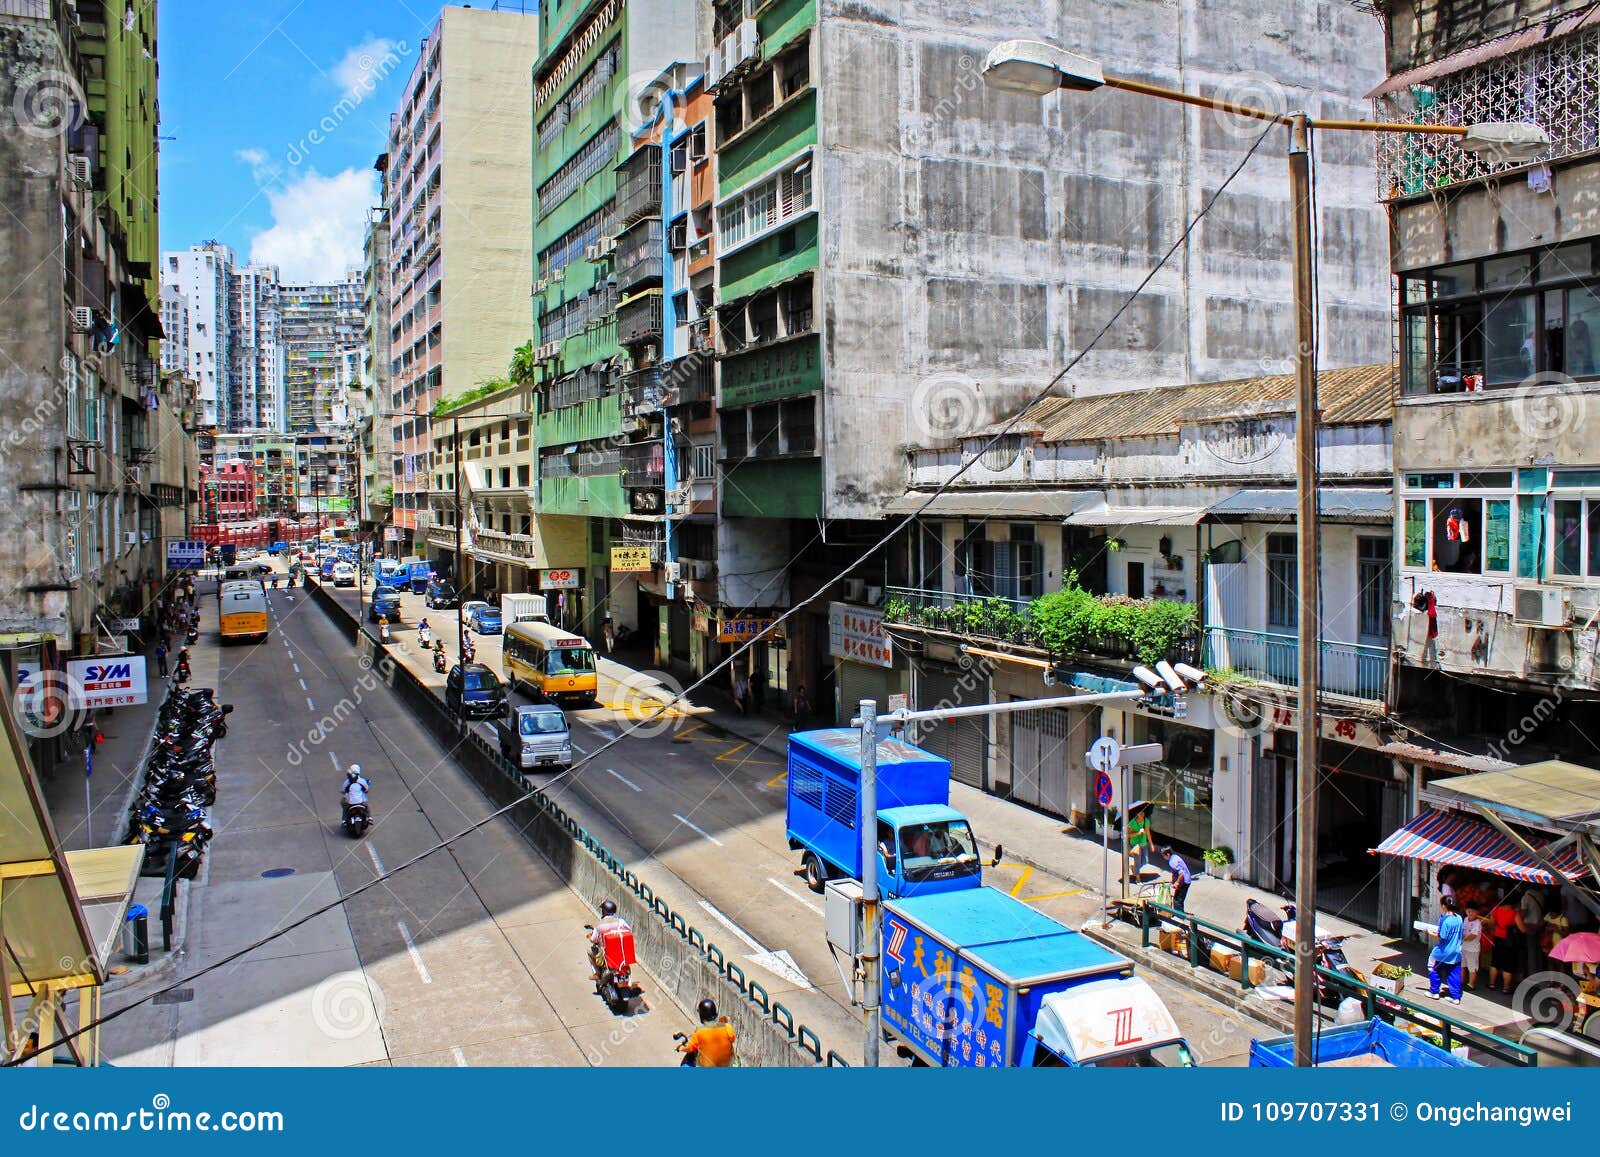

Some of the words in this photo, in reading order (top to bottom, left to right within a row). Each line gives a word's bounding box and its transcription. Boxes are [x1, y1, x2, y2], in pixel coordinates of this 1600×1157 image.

[85, 664, 130, 681] SYM
[913, 936, 1004, 1030] 天利電器
